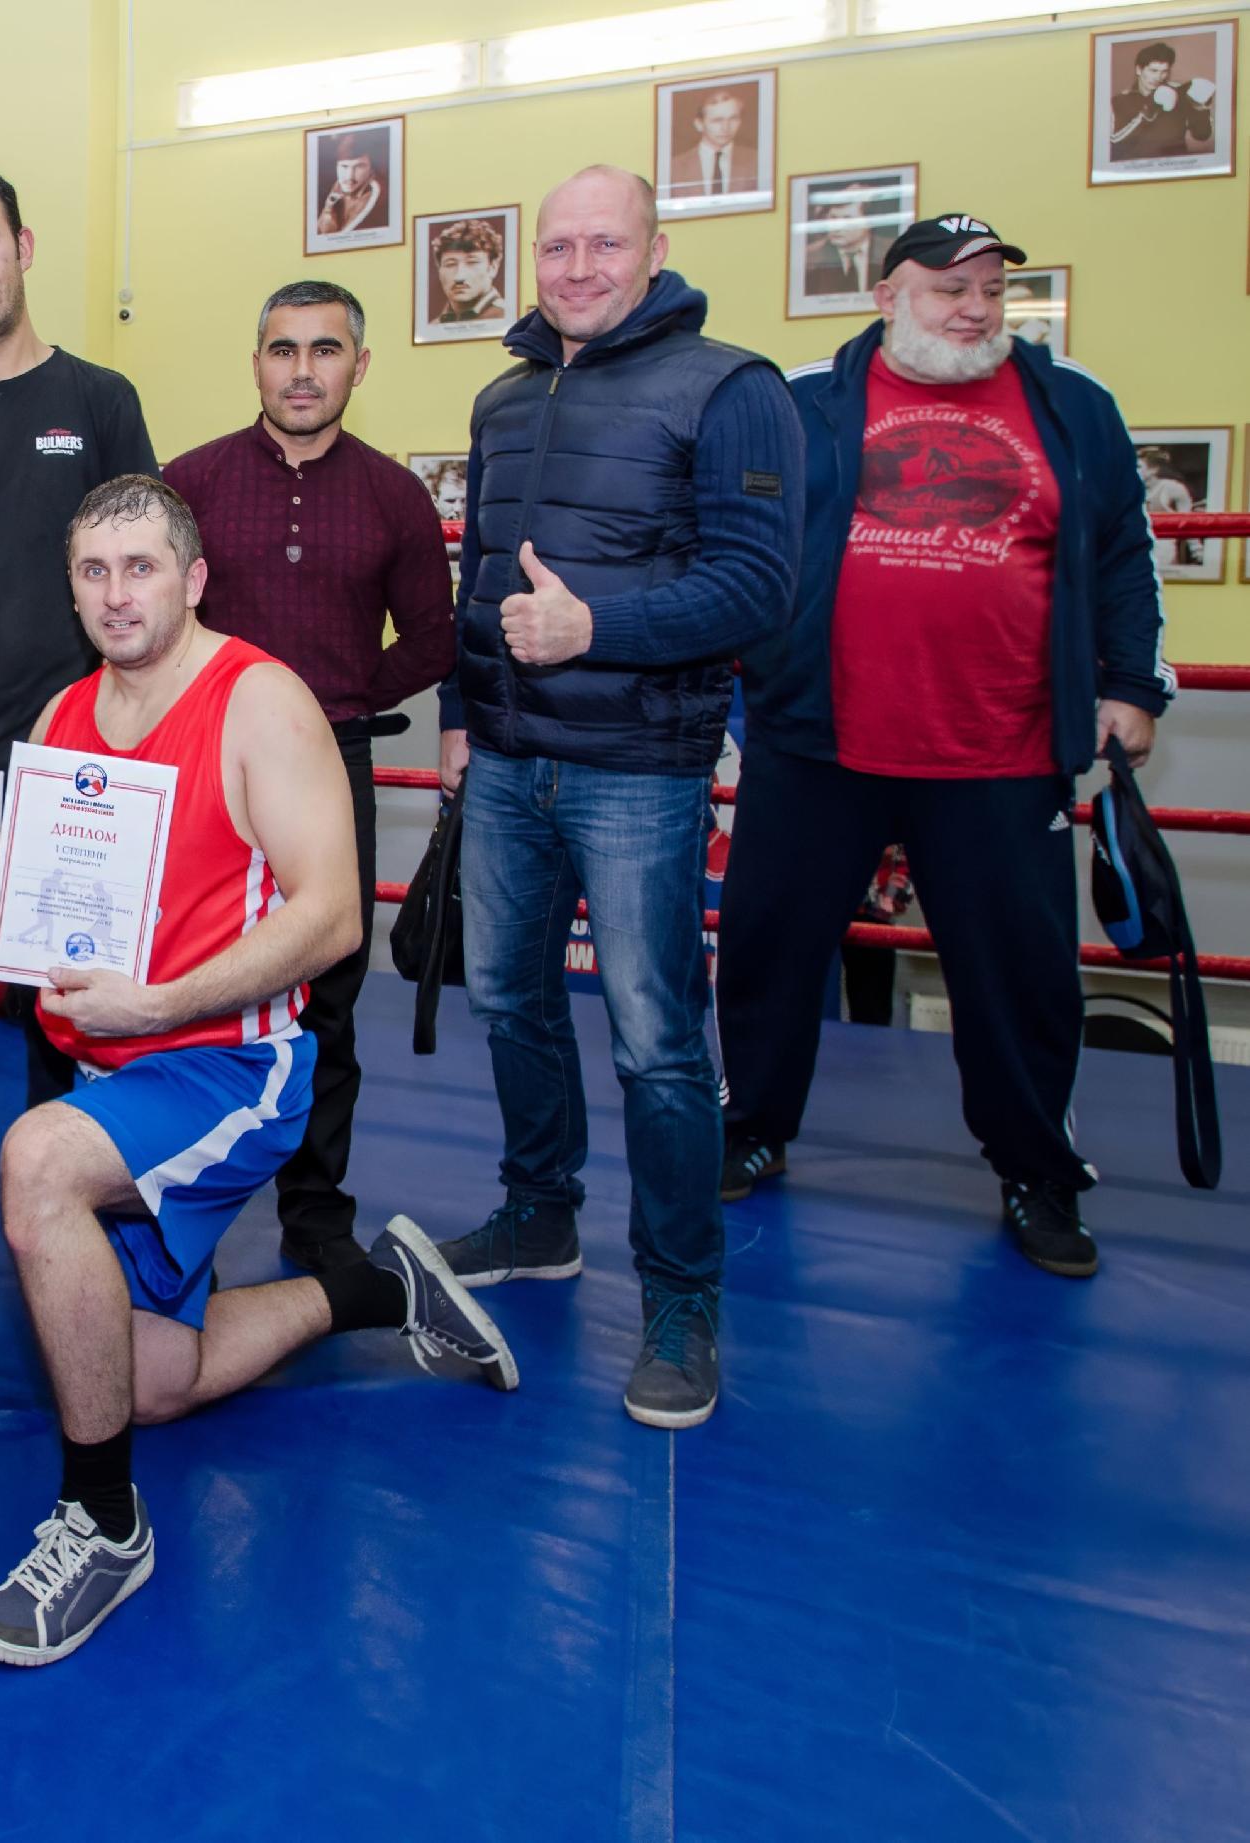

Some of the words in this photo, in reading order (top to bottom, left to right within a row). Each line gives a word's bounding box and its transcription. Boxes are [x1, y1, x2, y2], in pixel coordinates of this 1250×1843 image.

[864, 409, 965, 440] anhattan
[36, 435, 84, 451] BULMERS
[953, 527, 1014, 563] Surf
[50, 823, 117, 844] ДИПЛОМ
[62, 846, 107, 860] СТЕПЕНИ
